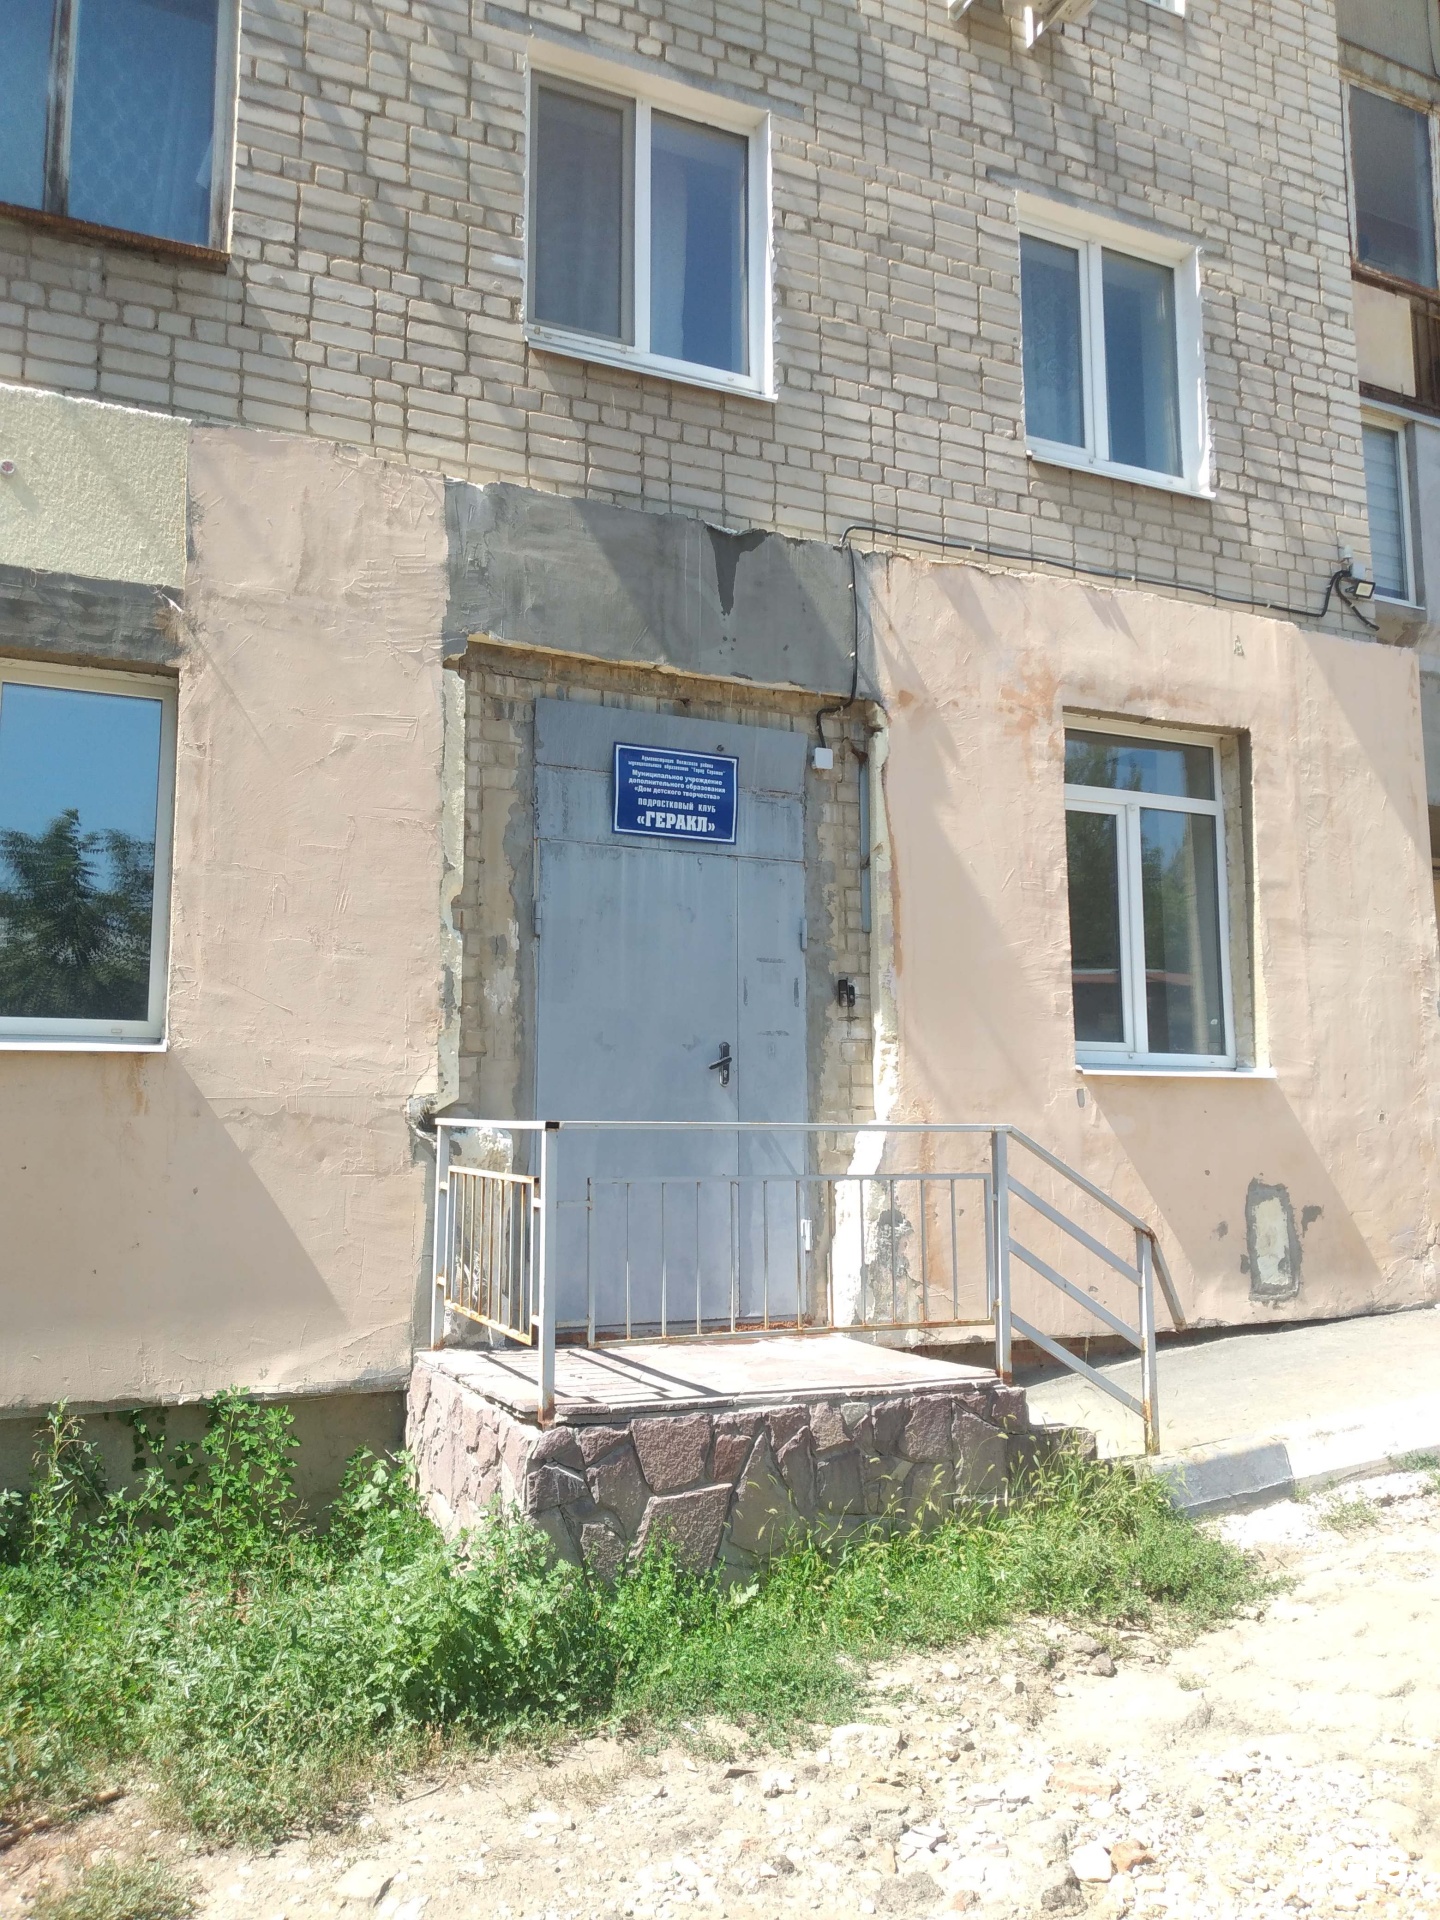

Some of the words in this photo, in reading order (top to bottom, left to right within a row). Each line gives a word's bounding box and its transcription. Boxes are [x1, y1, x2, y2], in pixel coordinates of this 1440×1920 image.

[628, 778, 684, 789] дополнительного
[686, 782, 726, 793] образования
[632, 769, 683, 781] Муниципальное
[685, 777, 722, 786] учреждение
[638, 798, 694, 810] ПОДРОСТКОВЫЙ
[698, 804, 716, 812] КЛУБ
[637, 811, 716, 832] «ГЕРАКЛ»
